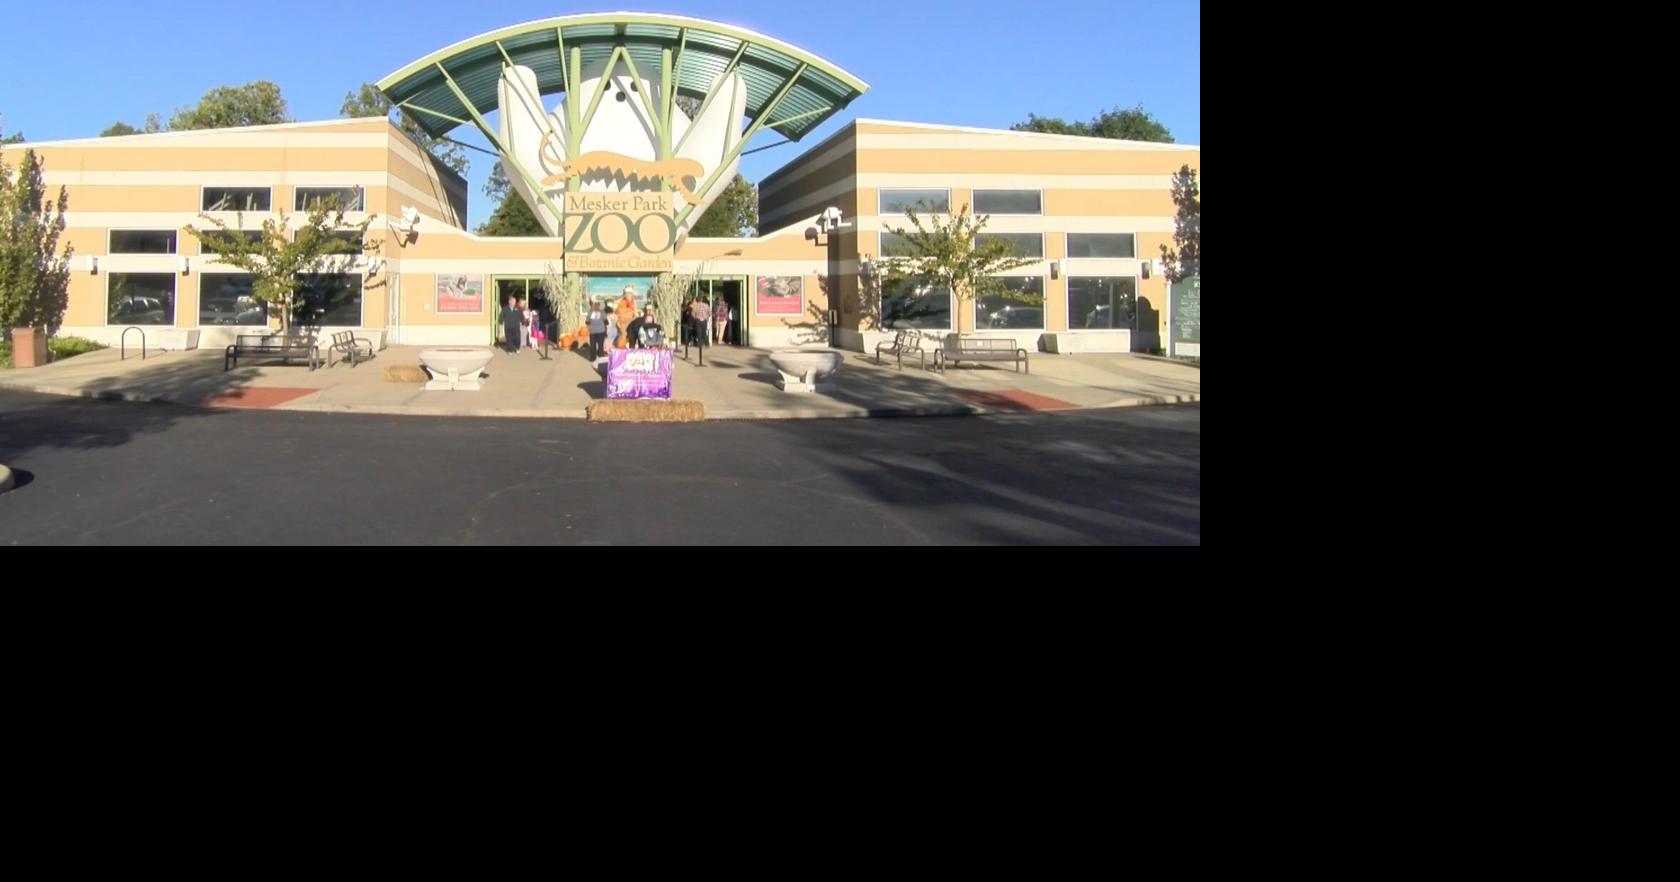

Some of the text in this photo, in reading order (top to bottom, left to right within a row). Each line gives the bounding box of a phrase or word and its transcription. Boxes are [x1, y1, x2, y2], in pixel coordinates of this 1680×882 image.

[570, 195, 668, 211] Mesker Park
[564, 212, 677, 254] ZOO
[627, 255, 672, 269] Garden
